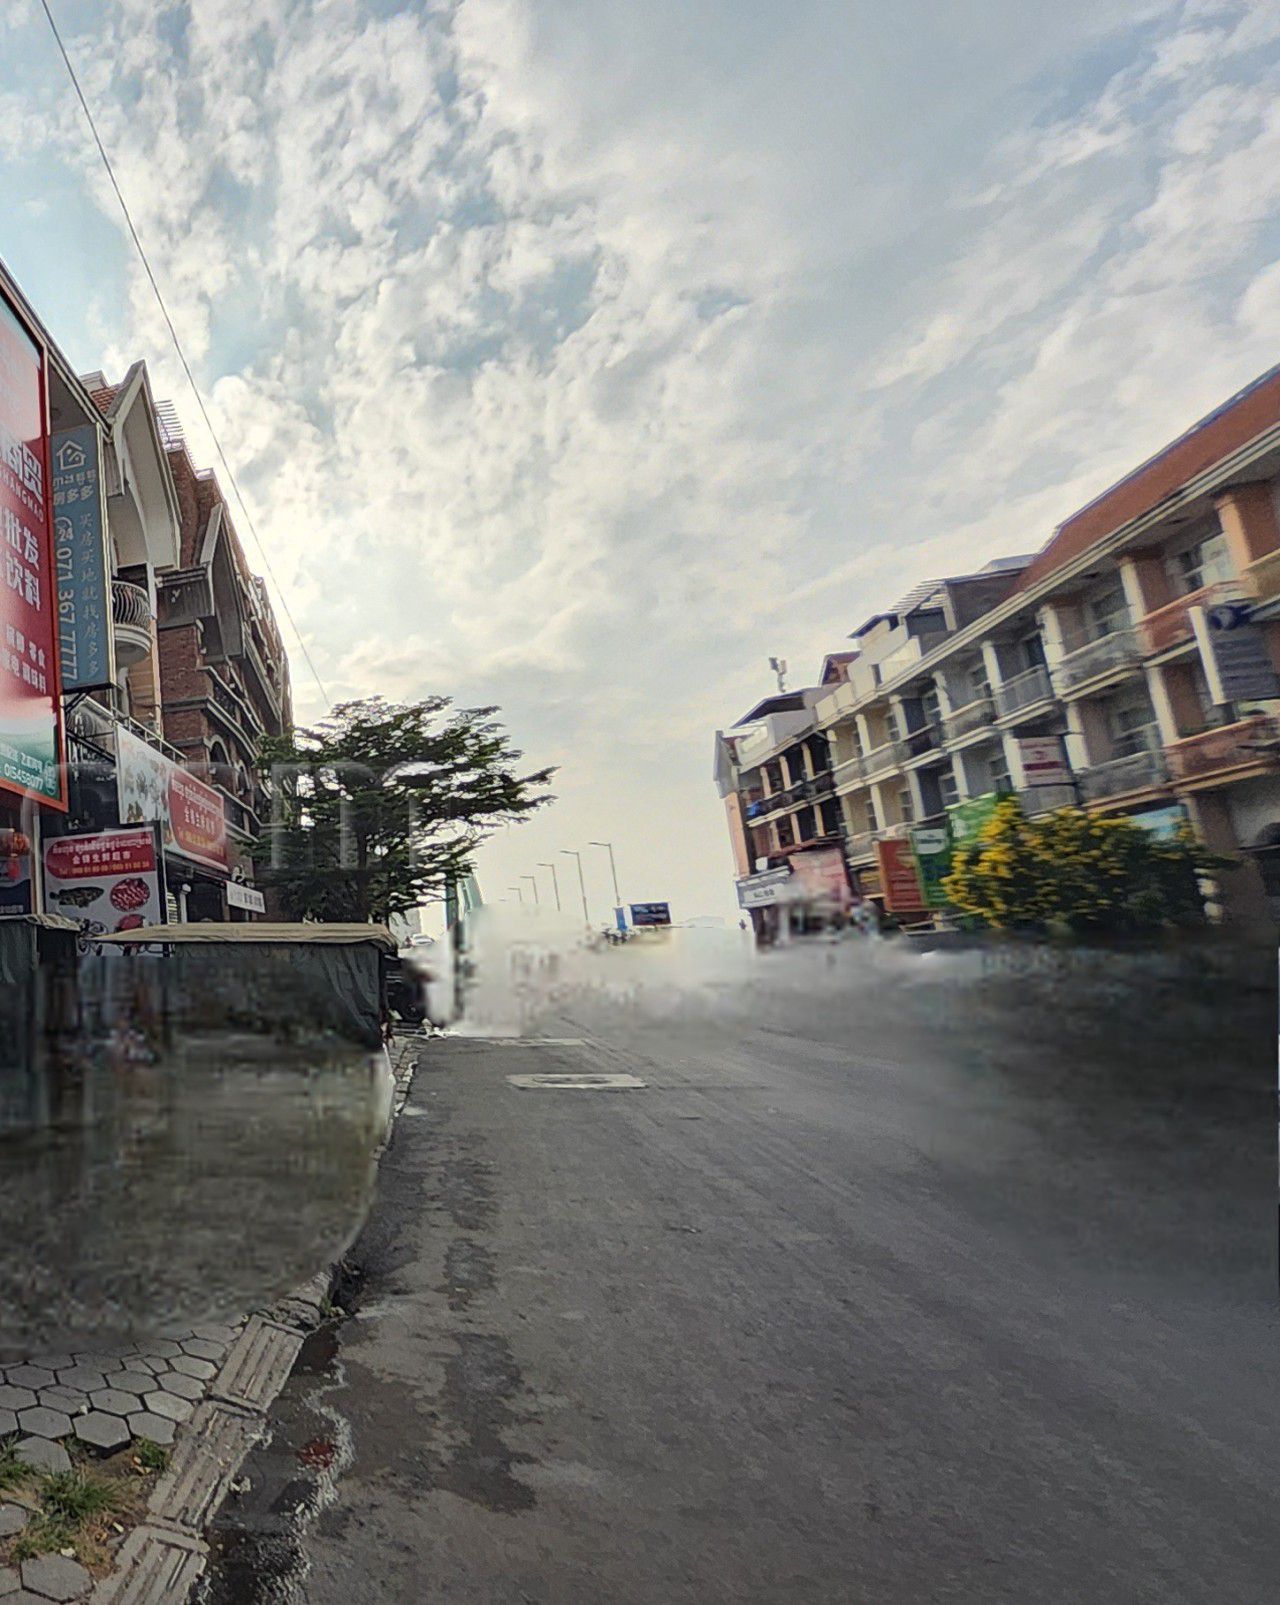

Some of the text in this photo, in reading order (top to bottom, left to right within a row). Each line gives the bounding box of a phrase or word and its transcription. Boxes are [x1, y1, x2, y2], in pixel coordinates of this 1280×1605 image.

[53, 485, 94, 507] 房多多
[56, 547, 78, 681] 071 367 7777
